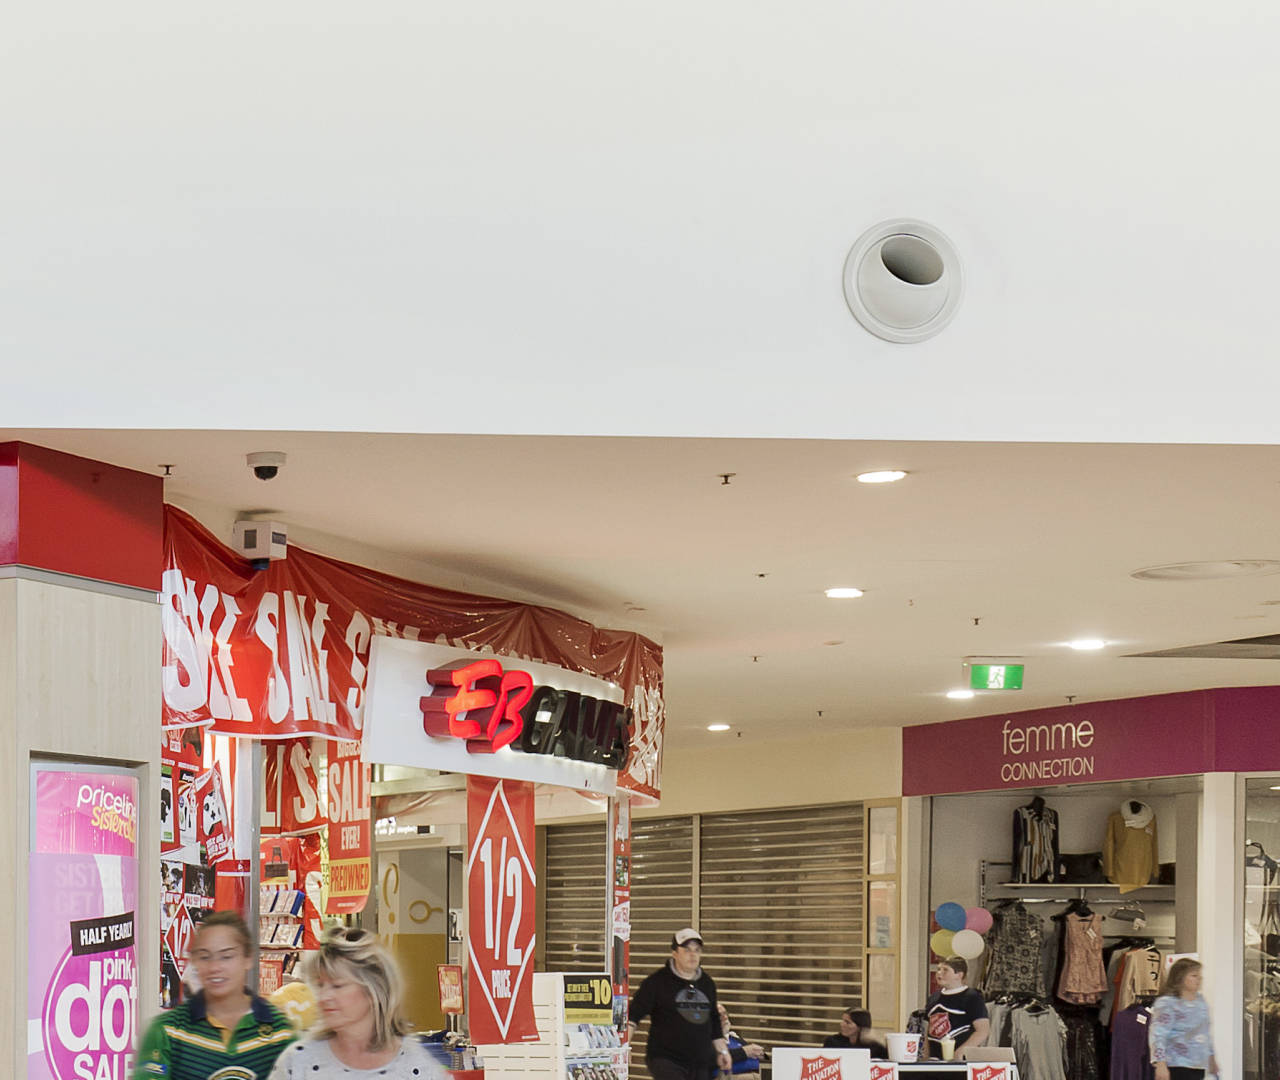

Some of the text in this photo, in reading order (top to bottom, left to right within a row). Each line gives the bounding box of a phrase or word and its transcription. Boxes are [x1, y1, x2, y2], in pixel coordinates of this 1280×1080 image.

[1002, 720, 1094, 755] femme
[1001, 756, 1094, 782] CONNECTION
[329, 759, 370, 823] SALE
[341, 825, 360, 849] EVER!
[331, 863, 369, 893] PREOWNED
[480, 836, 523, 967] 1/2
[80, 921, 133, 946] HALF YEARLY
[103, 951, 133, 981] pink
[492, 970, 512, 998] PRICE
[807, 1058, 824, 1075] THE
